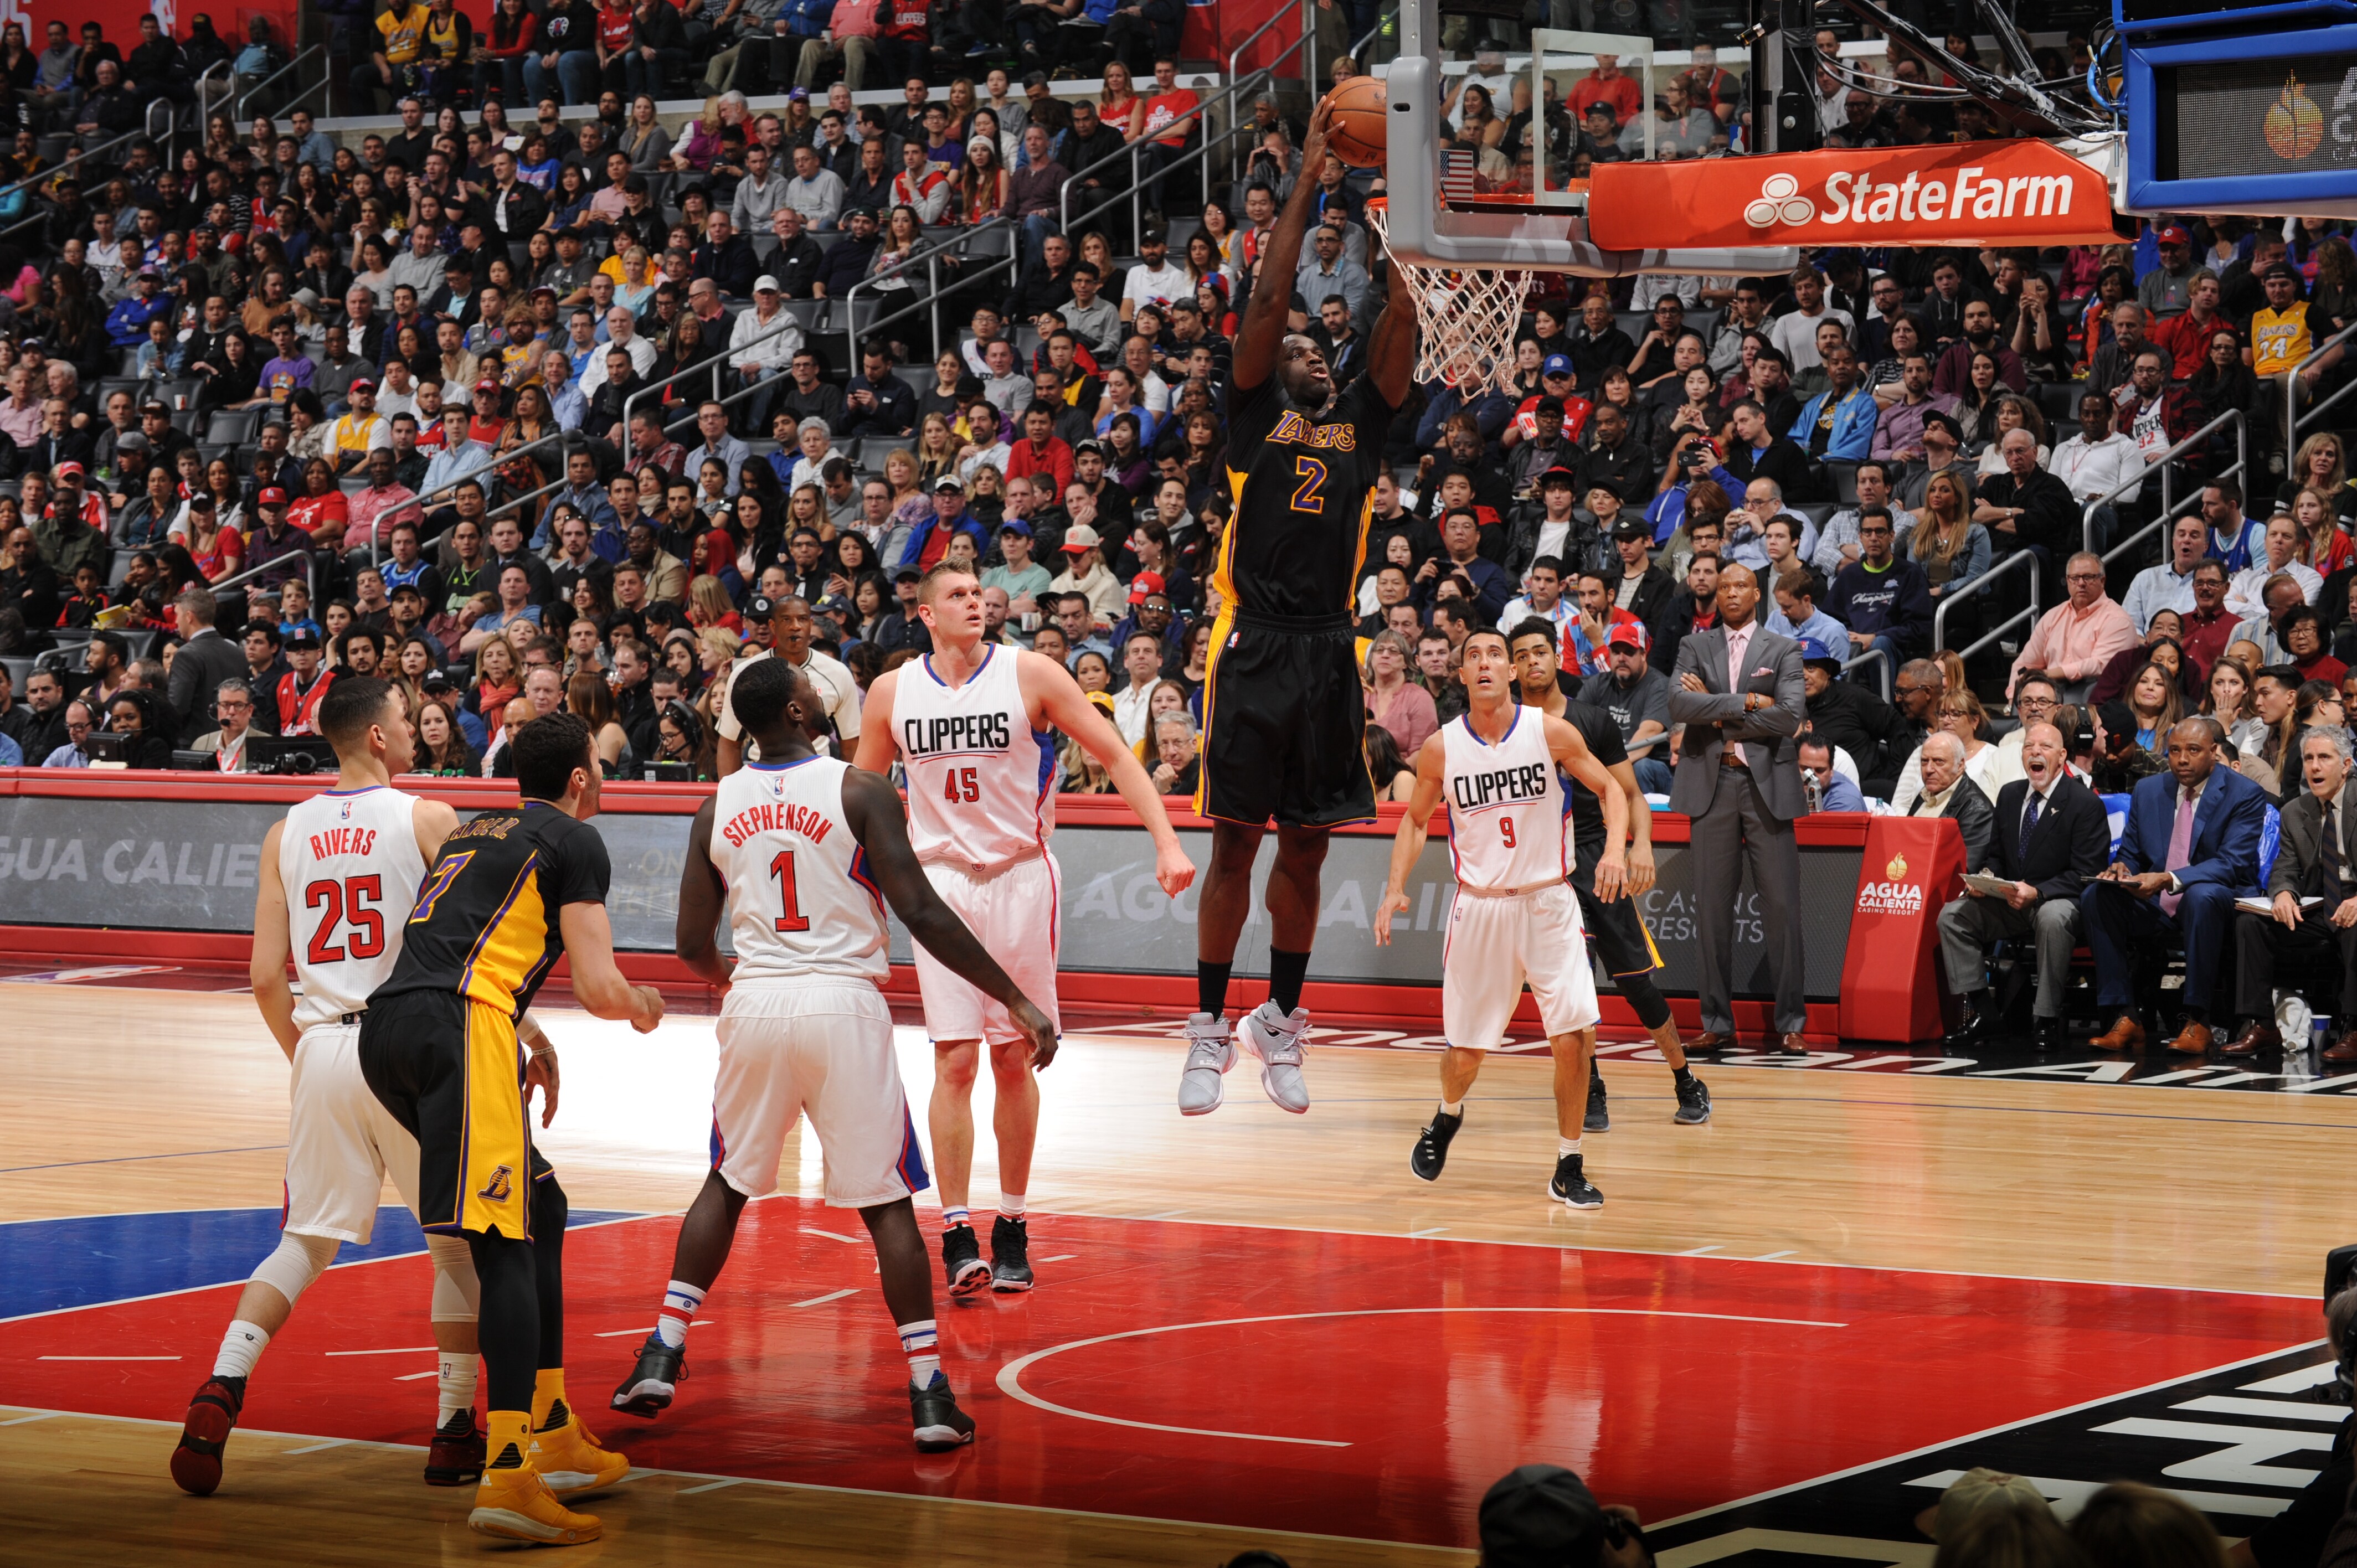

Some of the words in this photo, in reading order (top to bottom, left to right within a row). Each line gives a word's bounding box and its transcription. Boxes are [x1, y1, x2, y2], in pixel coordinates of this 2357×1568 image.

[1266, 410, 1356, 451] LAKERS
[1290, 456, 1327, 514] 2
[905, 712, 1010, 755] CLIPPERS
[945, 767, 980, 803] 45
[1454, 763, 1546, 809] CLIPPERS
[310, 827, 377, 862] RIVERS
[723, 803, 833, 848] STEPHENSON
[1500, 817, 1516, 848] 9
[409, 850, 476, 924] 7
[770, 850, 810, 932] 1
[1859, 896, 1921, 910] CALIENTE
[1860, 882, 1922, 900] AGUA
[306, 874, 385, 965] 25
[1642, 916, 1764, 943] RESTS
[1888, 907, 1916, 916] RESORT
